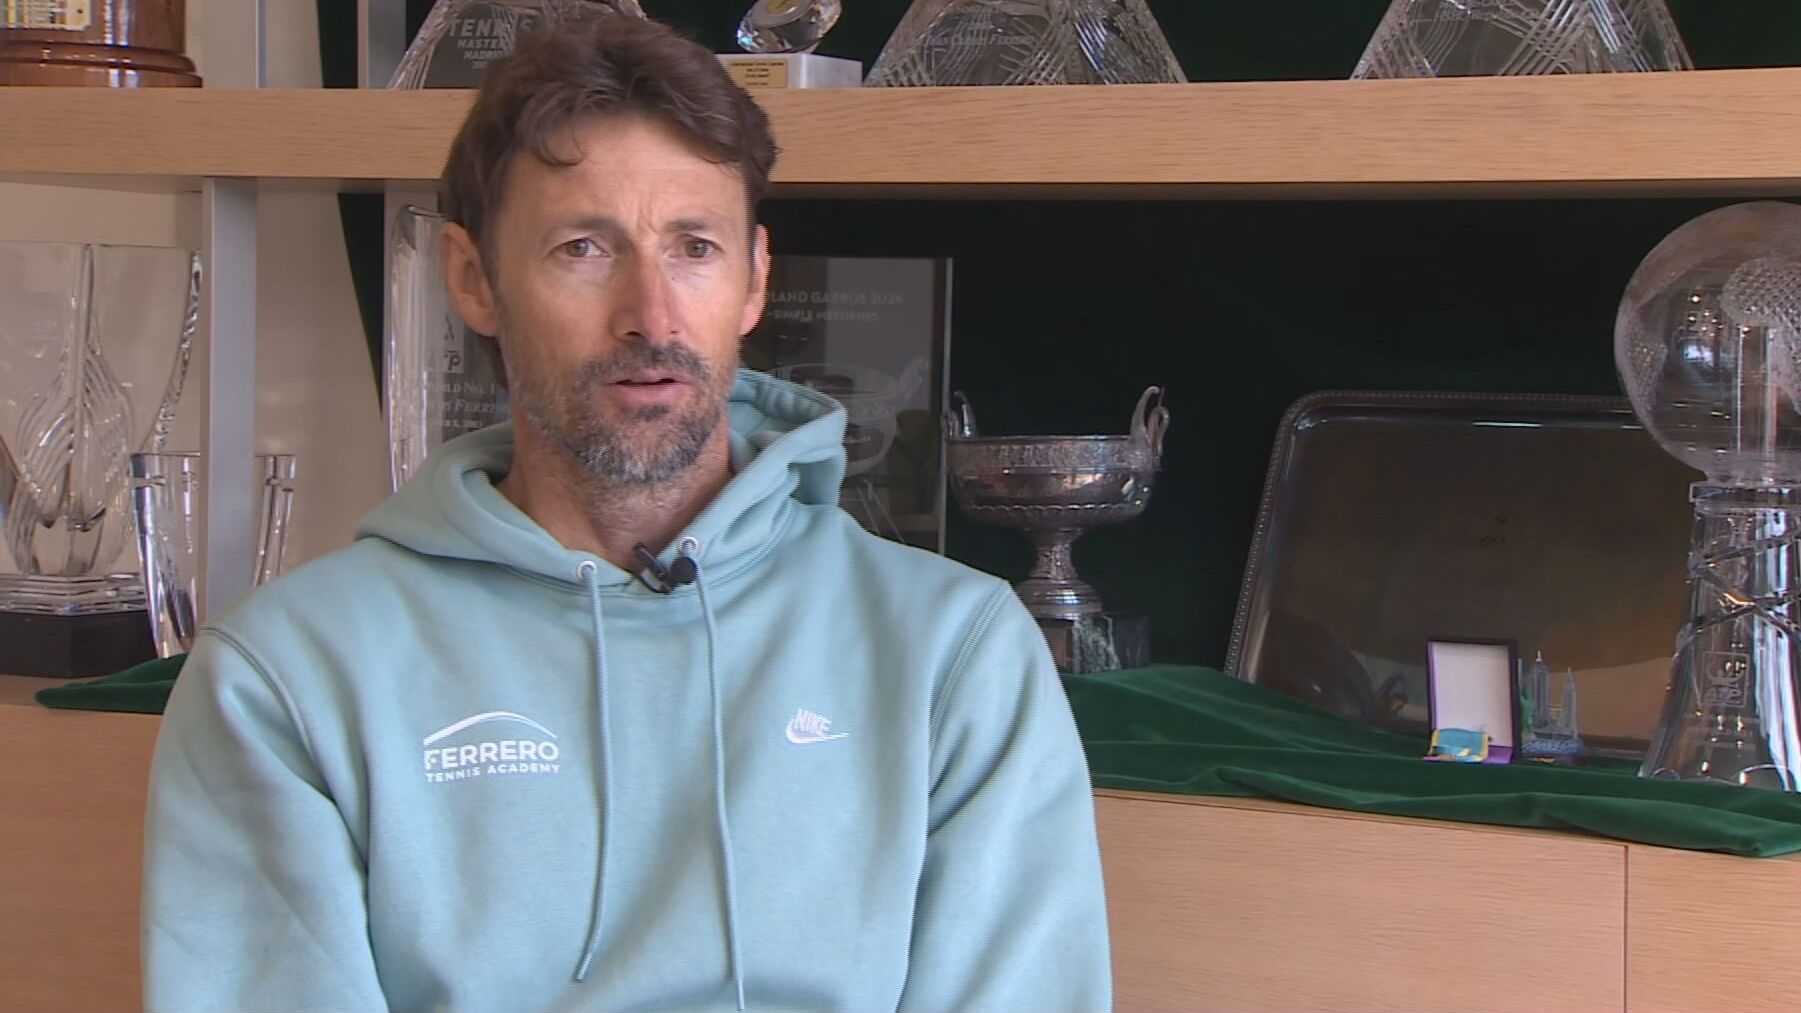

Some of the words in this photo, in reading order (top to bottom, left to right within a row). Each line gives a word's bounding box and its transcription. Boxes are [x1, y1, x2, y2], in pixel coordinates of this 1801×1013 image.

[795, 708, 832, 735] NIKE
[423, 740, 560, 771] FERRERO
[425, 767, 481, 783] TENNIS
[487, 763, 561, 774] ACADEMY
